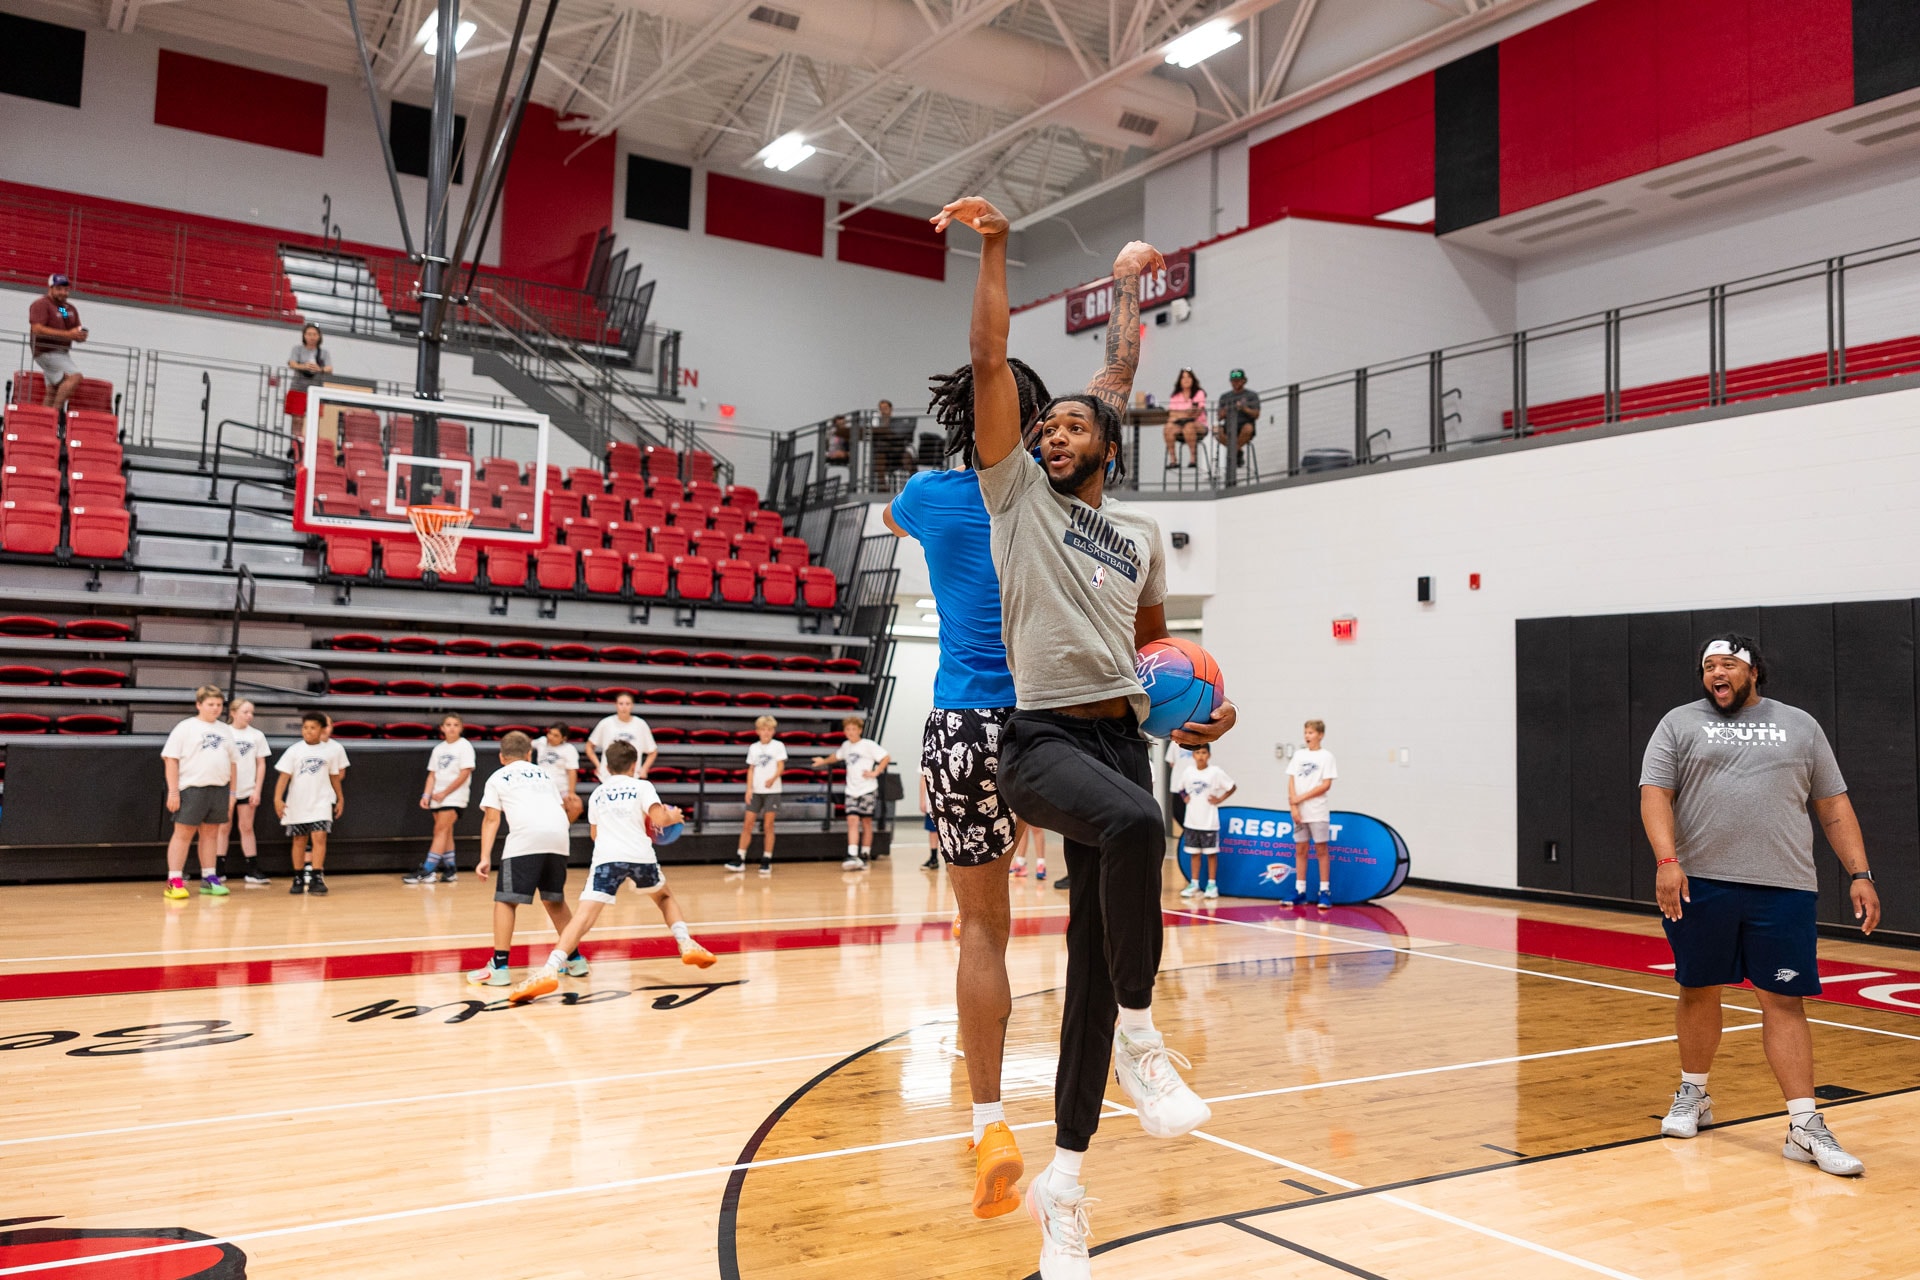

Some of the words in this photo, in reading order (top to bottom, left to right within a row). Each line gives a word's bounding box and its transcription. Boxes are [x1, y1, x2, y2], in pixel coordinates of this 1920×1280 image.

[1085, 268, 1167, 320] GRIIES
[1073, 537, 1131, 576] BASKETBALL
[1707, 721, 1777, 729] THUNDER
[1702, 726, 1786, 742] YOUTH
[1708, 739, 1780, 747] BASKETBALL
[1228, 817, 1343, 841] RESPT
[1224, 838, 1257, 847] RESPECT
